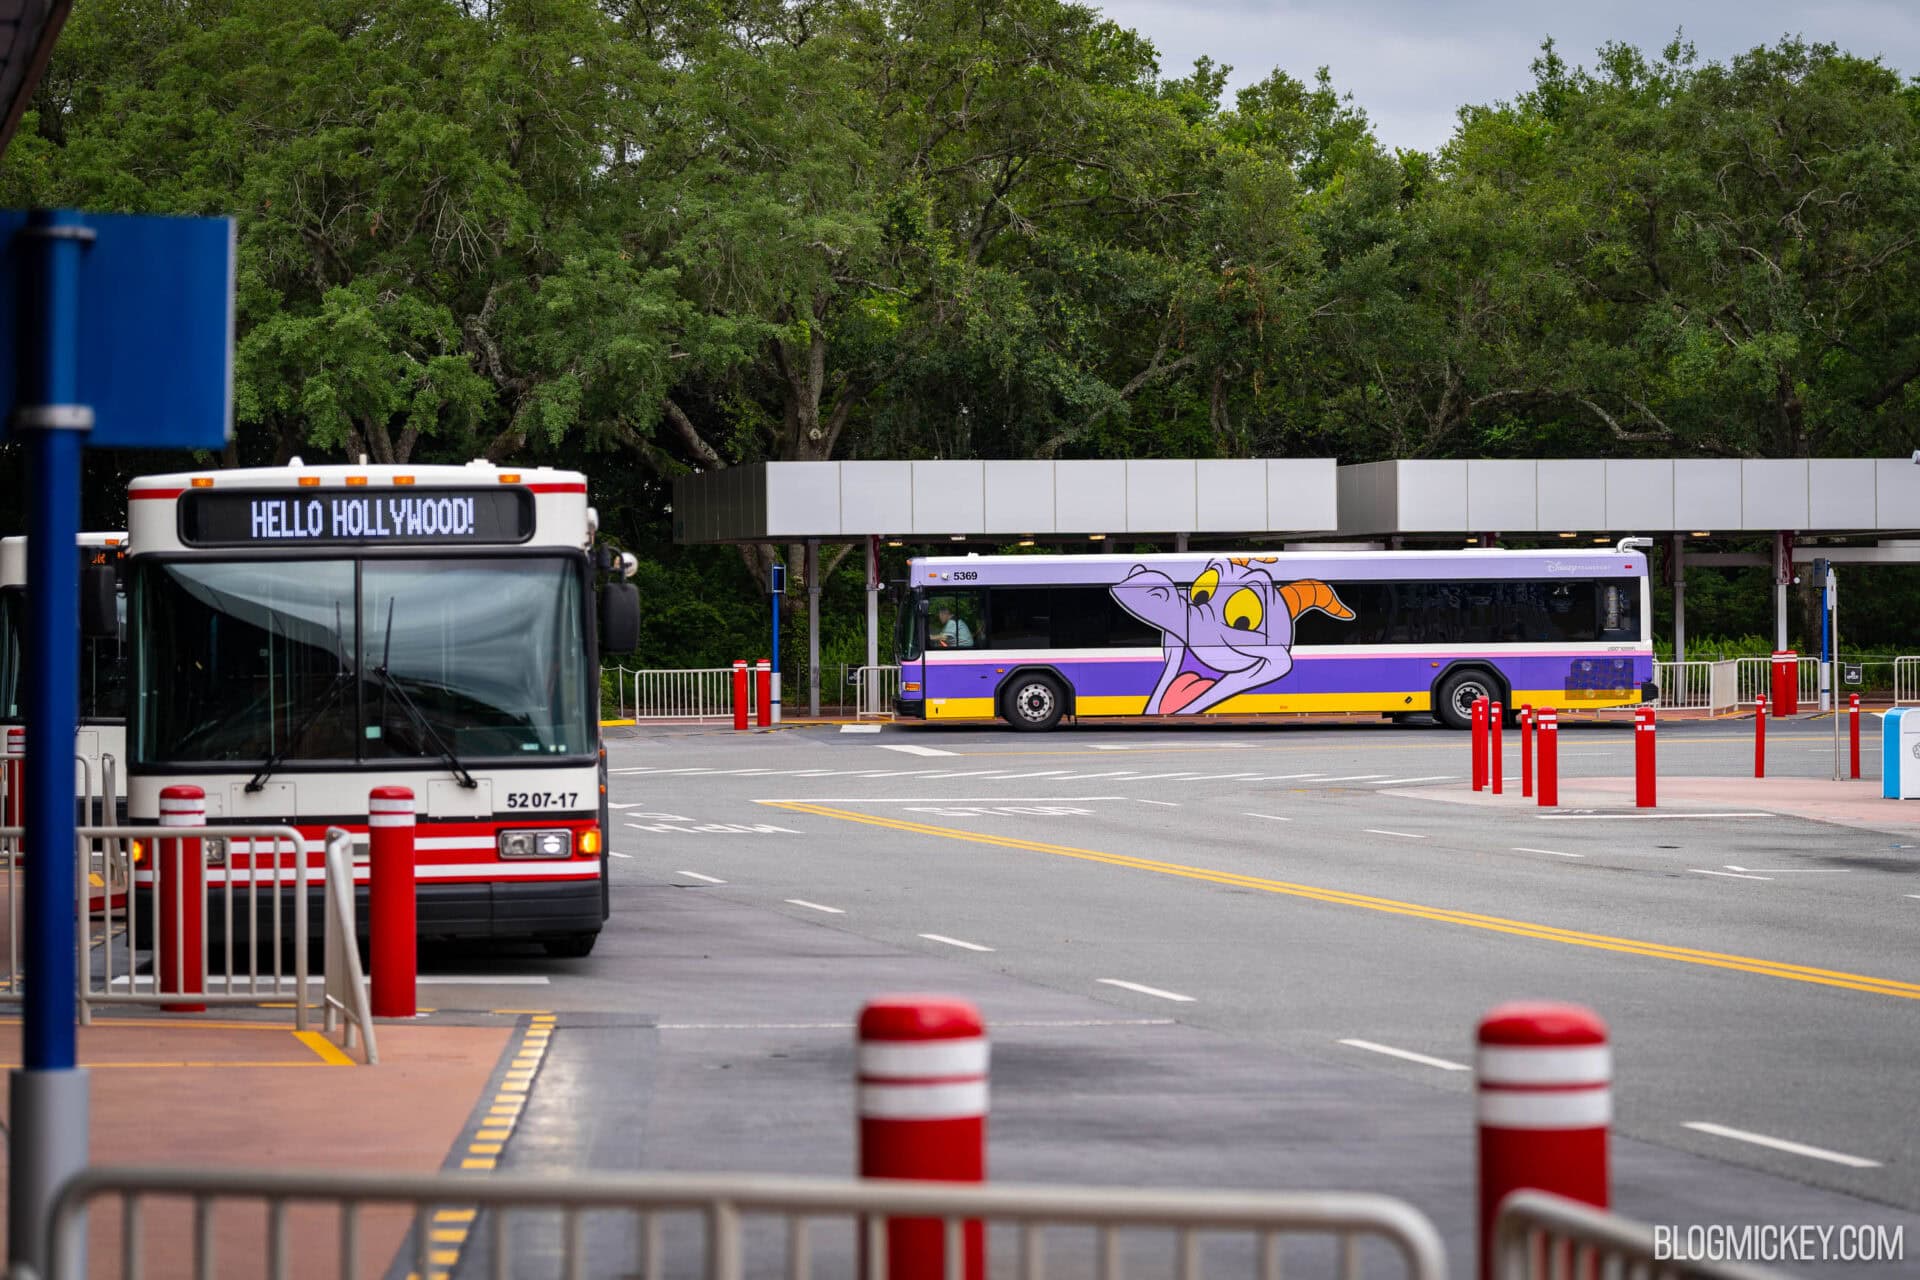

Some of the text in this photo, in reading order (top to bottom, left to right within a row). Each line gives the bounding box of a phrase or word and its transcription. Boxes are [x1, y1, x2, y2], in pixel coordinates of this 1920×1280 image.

[251, 498, 475, 538] HELLO HOLLYWOOD!
[953, 571, 978, 581] 5369
